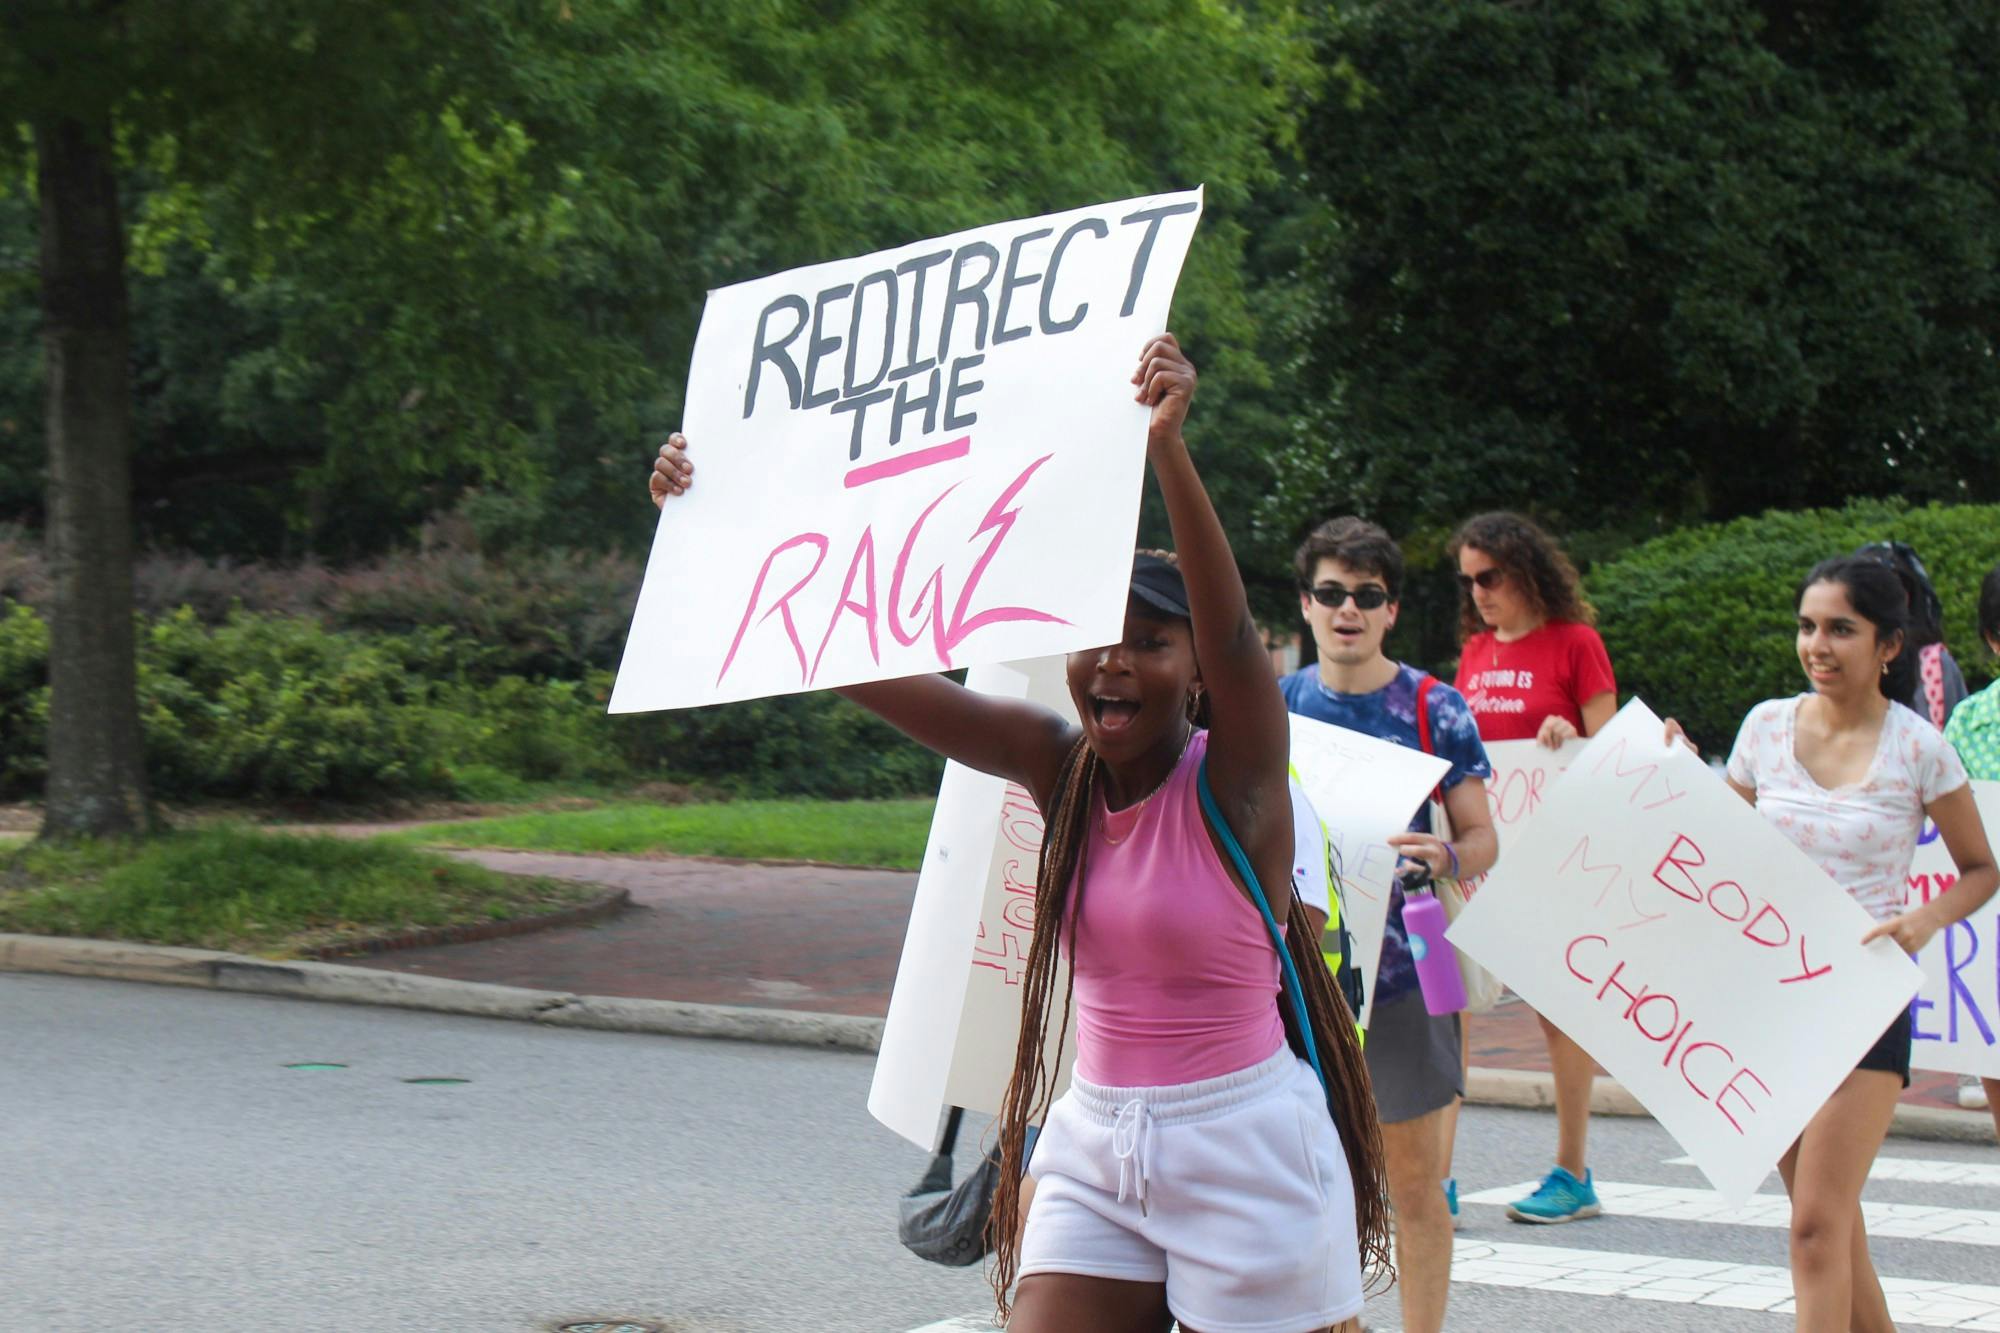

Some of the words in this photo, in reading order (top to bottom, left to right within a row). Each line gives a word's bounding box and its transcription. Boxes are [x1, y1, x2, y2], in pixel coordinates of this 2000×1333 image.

[742, 201, 1198, 420] REDIRECT
[830, 353, 986, 462] THE
[716, 451, 1080, 688] RAGE
[1517, 670, 1534, 689] ES
[1591, 737, 1687, 811] MY
[1557, 833, 1667, 931] MY
[1651, 832, 1833, 986] BODY
[1564, 933, 1774, 1137] CHOICE
